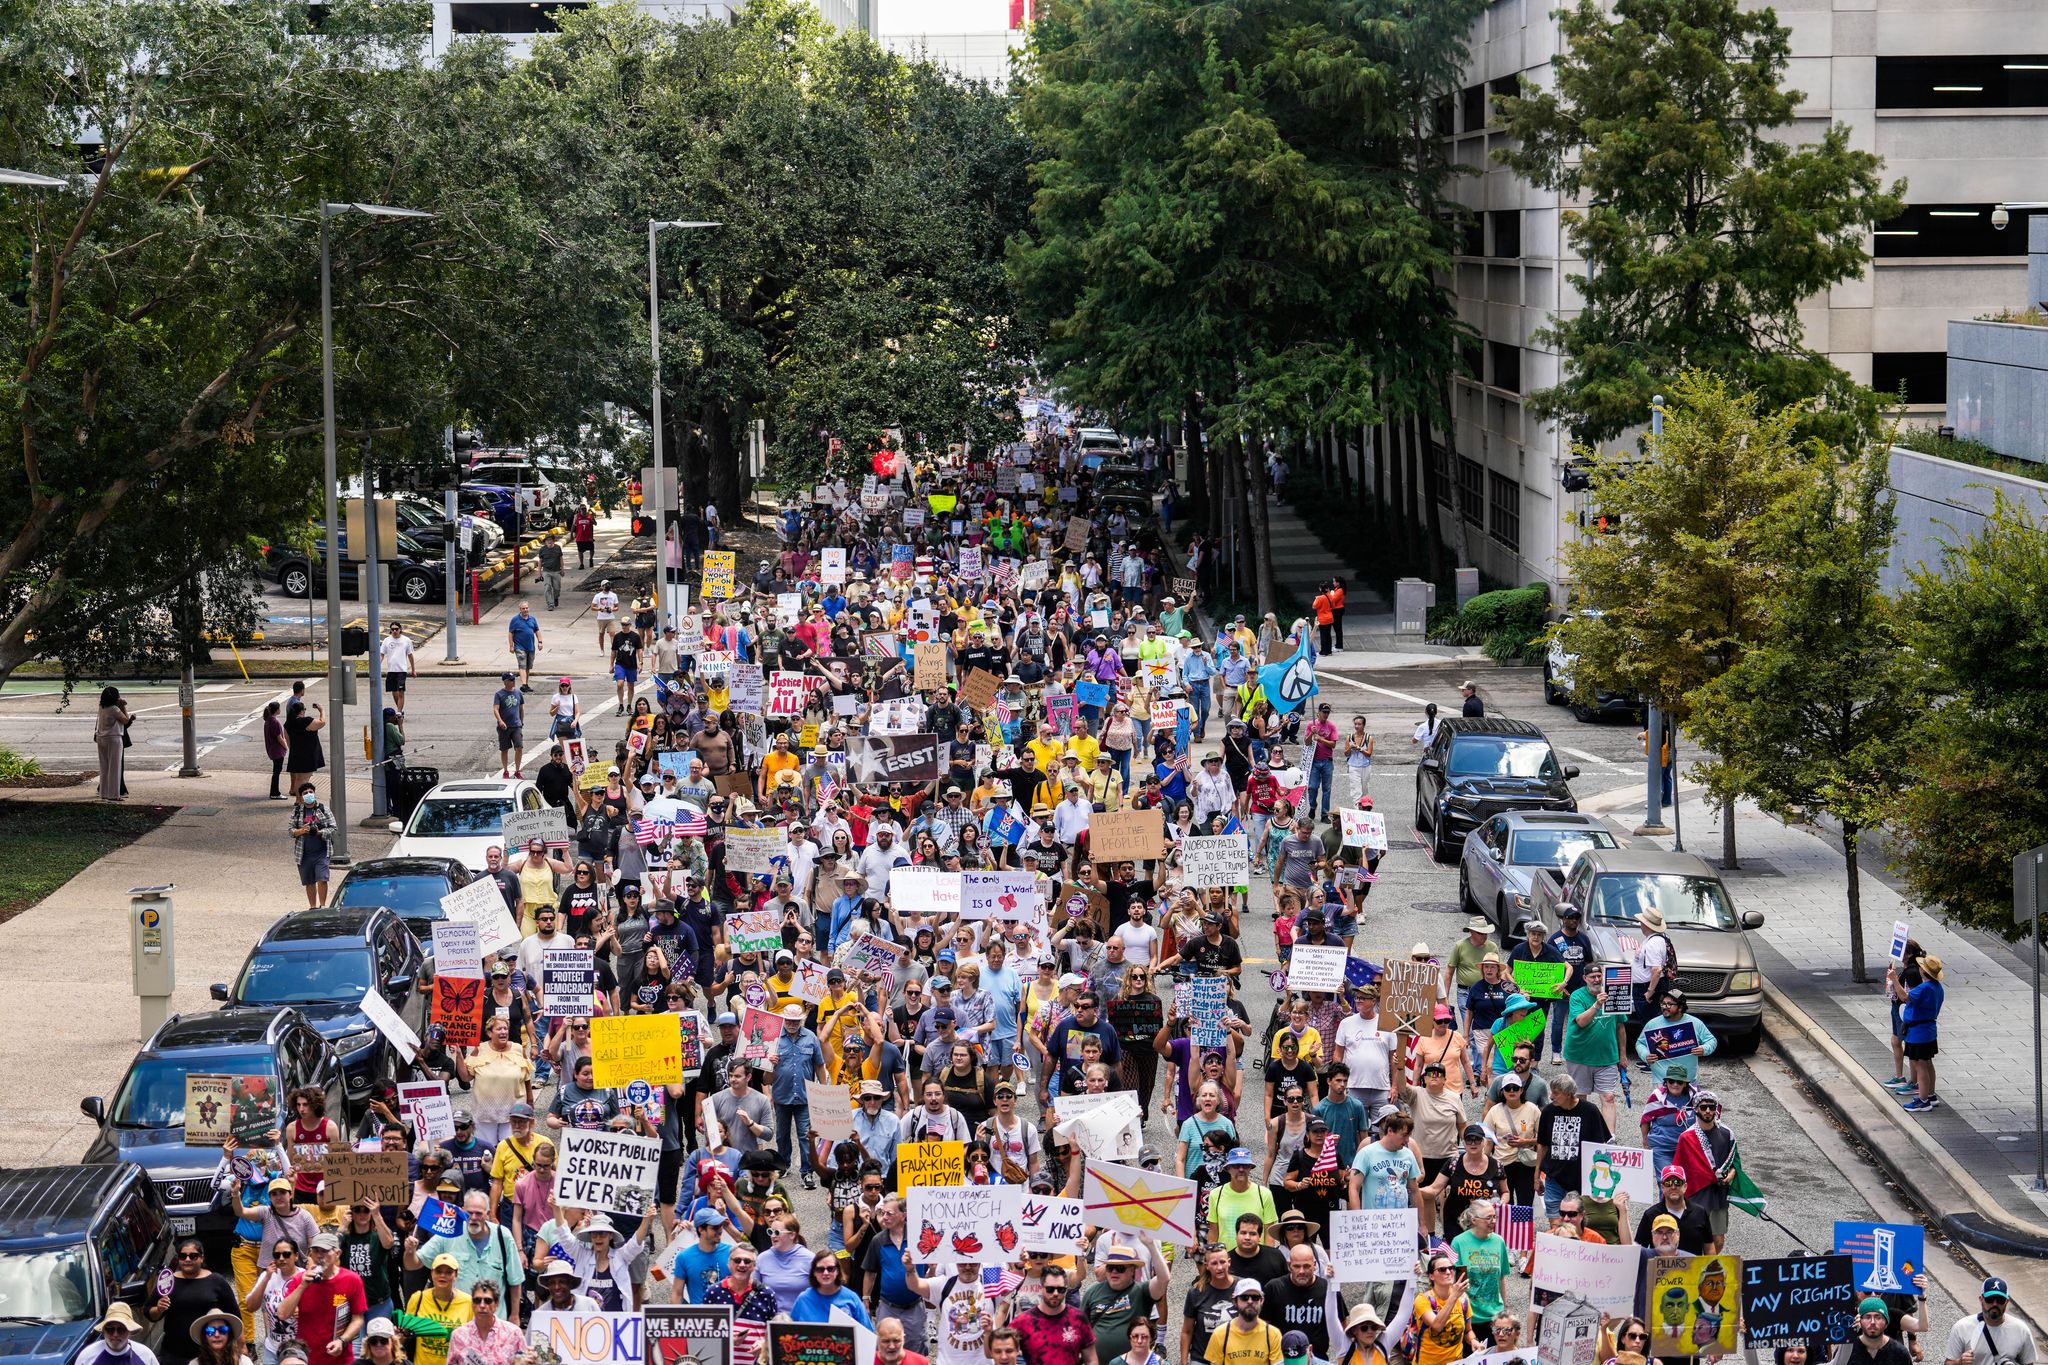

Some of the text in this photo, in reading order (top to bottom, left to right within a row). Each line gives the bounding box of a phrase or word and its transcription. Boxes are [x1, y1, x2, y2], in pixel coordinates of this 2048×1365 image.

[968, 470, 993, 480] KINGS
[960, 570, 982, 578] POWER
[1174, 579, 1196, 588] DEFEAT
[924, 645, 940, 654] NO
[702, 653, 716, 662] NO
[702, 662, 731, 672] KINGS
[918, 657, 943, 670] Kings
[771, 672, 801, 688] Justice
[919, 670, 943, 680] Since
[920, 680, 943, 688] 1776
[776, 688, 794, 696] for
[772, 697, 799, 714] ALL
[1052, 698, 1071, 706] RESIST
[1177, 710, 1190, 720] NO
[683, 788, 706, 796] DUKE
[504, 808, 566, 828] AMERICAN PATRIOT
[1096, 814, 1132, 826] POWER
[517, 823, 540, 832] PROTECT
[1356, 824, 1370, 834] NOT
[510, 831, 568, 846] CONSTITUTION
[1184, 838, 1238, 850] NOBODY PAID
[1184, 850, 1246, 861] ME HERE
[1198, 861, 1248, 872] HATE TRUMP
[964, 874, 1000, 885] The only
[1214, 872, 1238, 884] FREE
[1012, 885, 1034, 894] Want
[932, 890, 959, 902] Hate
[144, 911, 157, 928] P
[751, 912, 772, 922] NO
[436, 930, 476, 939] DEMOCRACY
[438, 959, 468, 967] DICTATORS
[558, 954, 588, 962] AMERICA
[1386, 960, 1402, 982] SIN
[552, 972, 585, 982] PROTECT
[545, 982, 592, 994] DEMOCRACY
[1392, 982, 1424, 996] NO HAY
[550, 1004, 588, 1014] PRESIDENT!
[1386, 995, 1429, 1015] CORONA
[1193, 1011, 1226, 1020] RELEASE
[435, 1022, 477, 1030] ORANGE
[594, 1019, 628, 1032] ONLY
[601, 1028, 667, 1044] DEMOCRACY
[1192, 1028, 1227, 1038] EPSTEIN
[596, 1045, 646, 1060] CAN END
[1554, 1122, 1580, 1132] REICH
[294, 1144, 328, 1155] TRANS
[567, 1137, 660, 1163] WORST PUBLIC
[920, 1144, 942, 1158] NO
[356, 1154, 376, 1164] FEAR
[1612, 1151, 1643, 1168] RESIST
[567, 1157, 646, 1182] SERVANT
[1373, 1160, 1391, 1172] GOOD
[1464, 1180, 1482, 1188] NO
[326, 1180, 408, 1204] I Dissent
[559, 1178, 614, 1205] EVER
[959, 1190, 991, 1198] ORANGE
[1458, 1187, 1492, 1198] KINGS.
[922, 1200, 1002, 1218] MONARCH
[1061, 1204, 1080, 1216] NO
[437, 1218, 456, 1228] NO
[949, 1221, 978, 1230] WANT
[432, 1224, 455, 1234] KINGS
[1049, 1222, 1082, 1240] KINGS
[1656, 1258, 1686, 1268] PILLARS
[1747, 1262, 1827, 1284] I LIKE
[1575, 1275, 1590, 1290] job
[1656, 1277, 1683, 1286] POWER
[1751, 1284, 1852, 1312] MY RIGHTS
[1285, 1300, 1324, 1324] nein
[646, 1318, 729, 1330] WE HAVE A
[1567, 1317, 1597, 1326] MISSING
[646, 1329, 729, 1338] CONSTITUTION
[1750, 1318, 1821, 1340] WITH NO
[551, 1316, 612, 1361] NO
[1772, 1338, 1810, 1348] KINGS!
[782, 1338, 852, 1354] DEMOCRACY
[1227, 1350, 1264, 1360] TRUST ME
